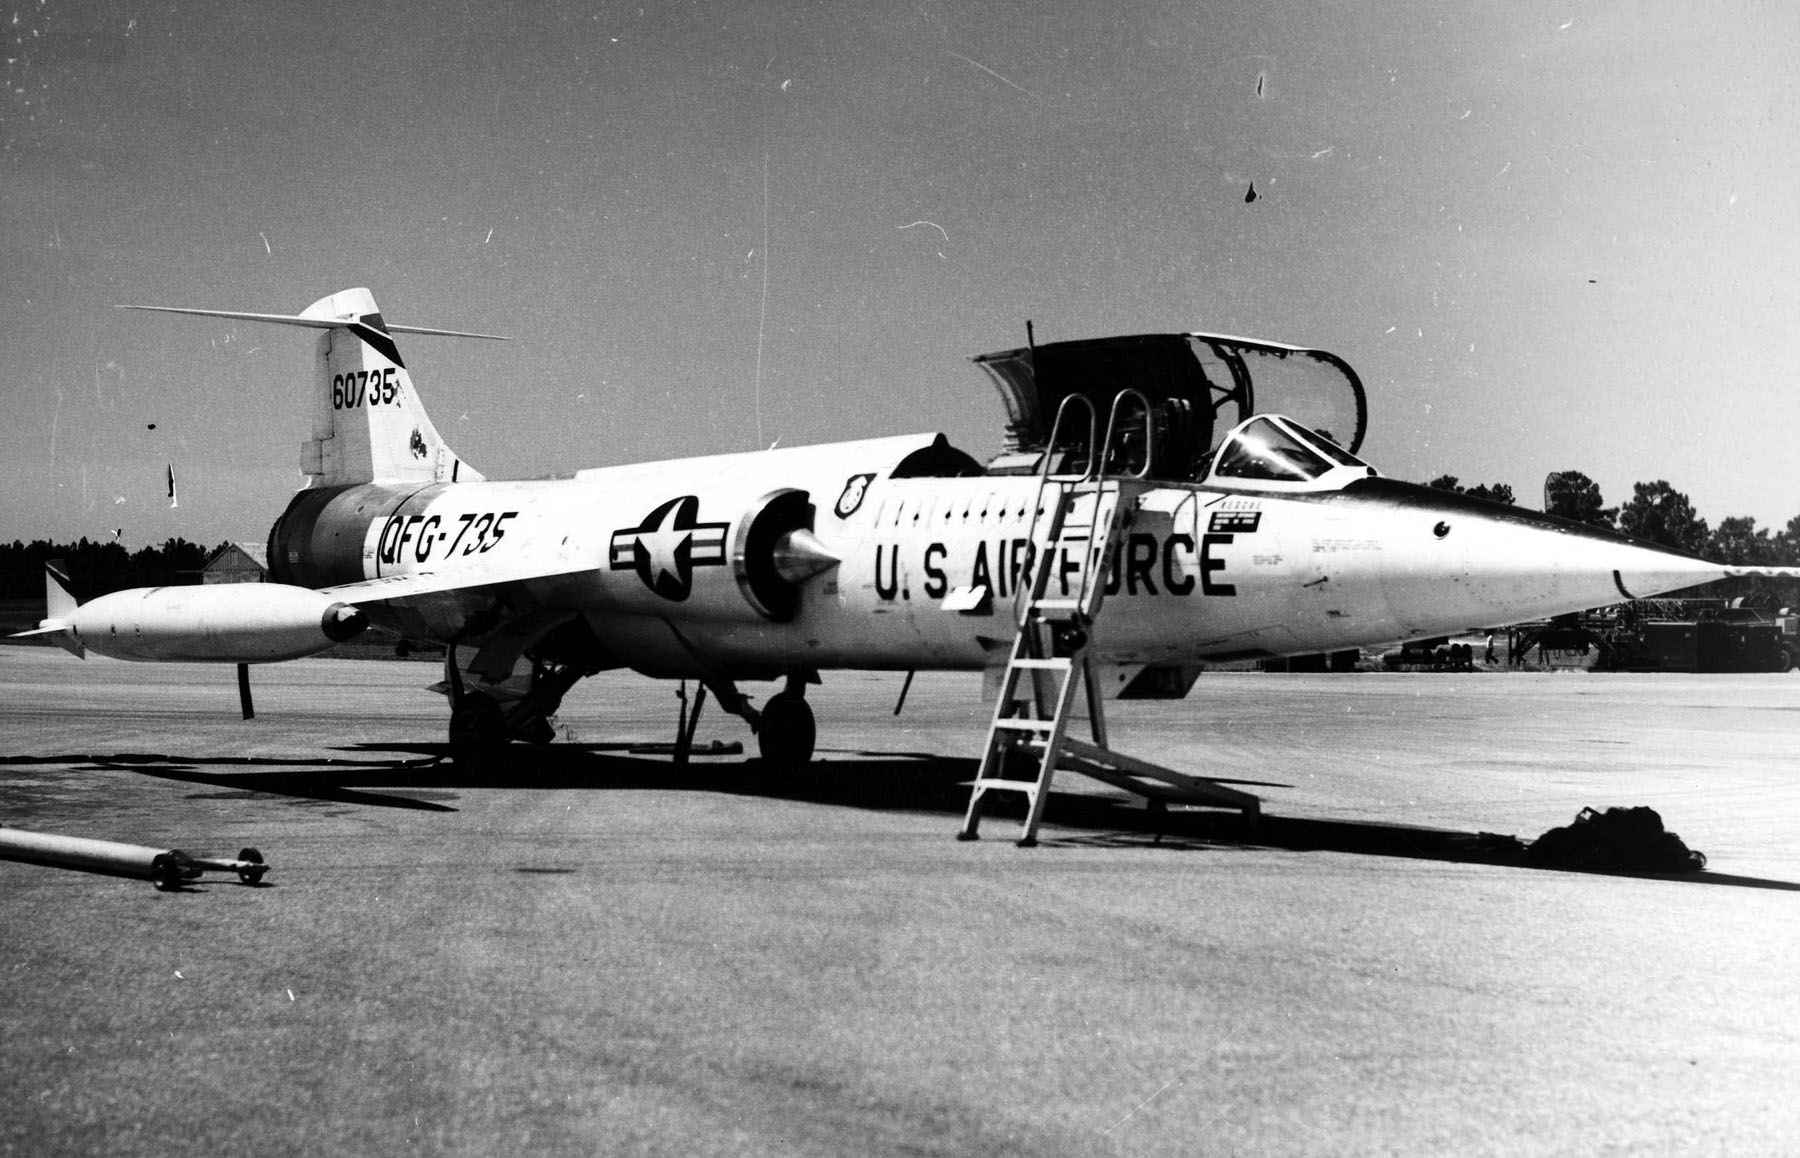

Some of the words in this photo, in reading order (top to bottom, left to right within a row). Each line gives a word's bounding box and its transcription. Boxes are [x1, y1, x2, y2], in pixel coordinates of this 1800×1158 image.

[333, 367, 396, 410] 60735
[380, 511, 519, 565] QFG-735
[972, 538, 1037, 598] AIR
[1060, 533, 1237, 597] FORCE
